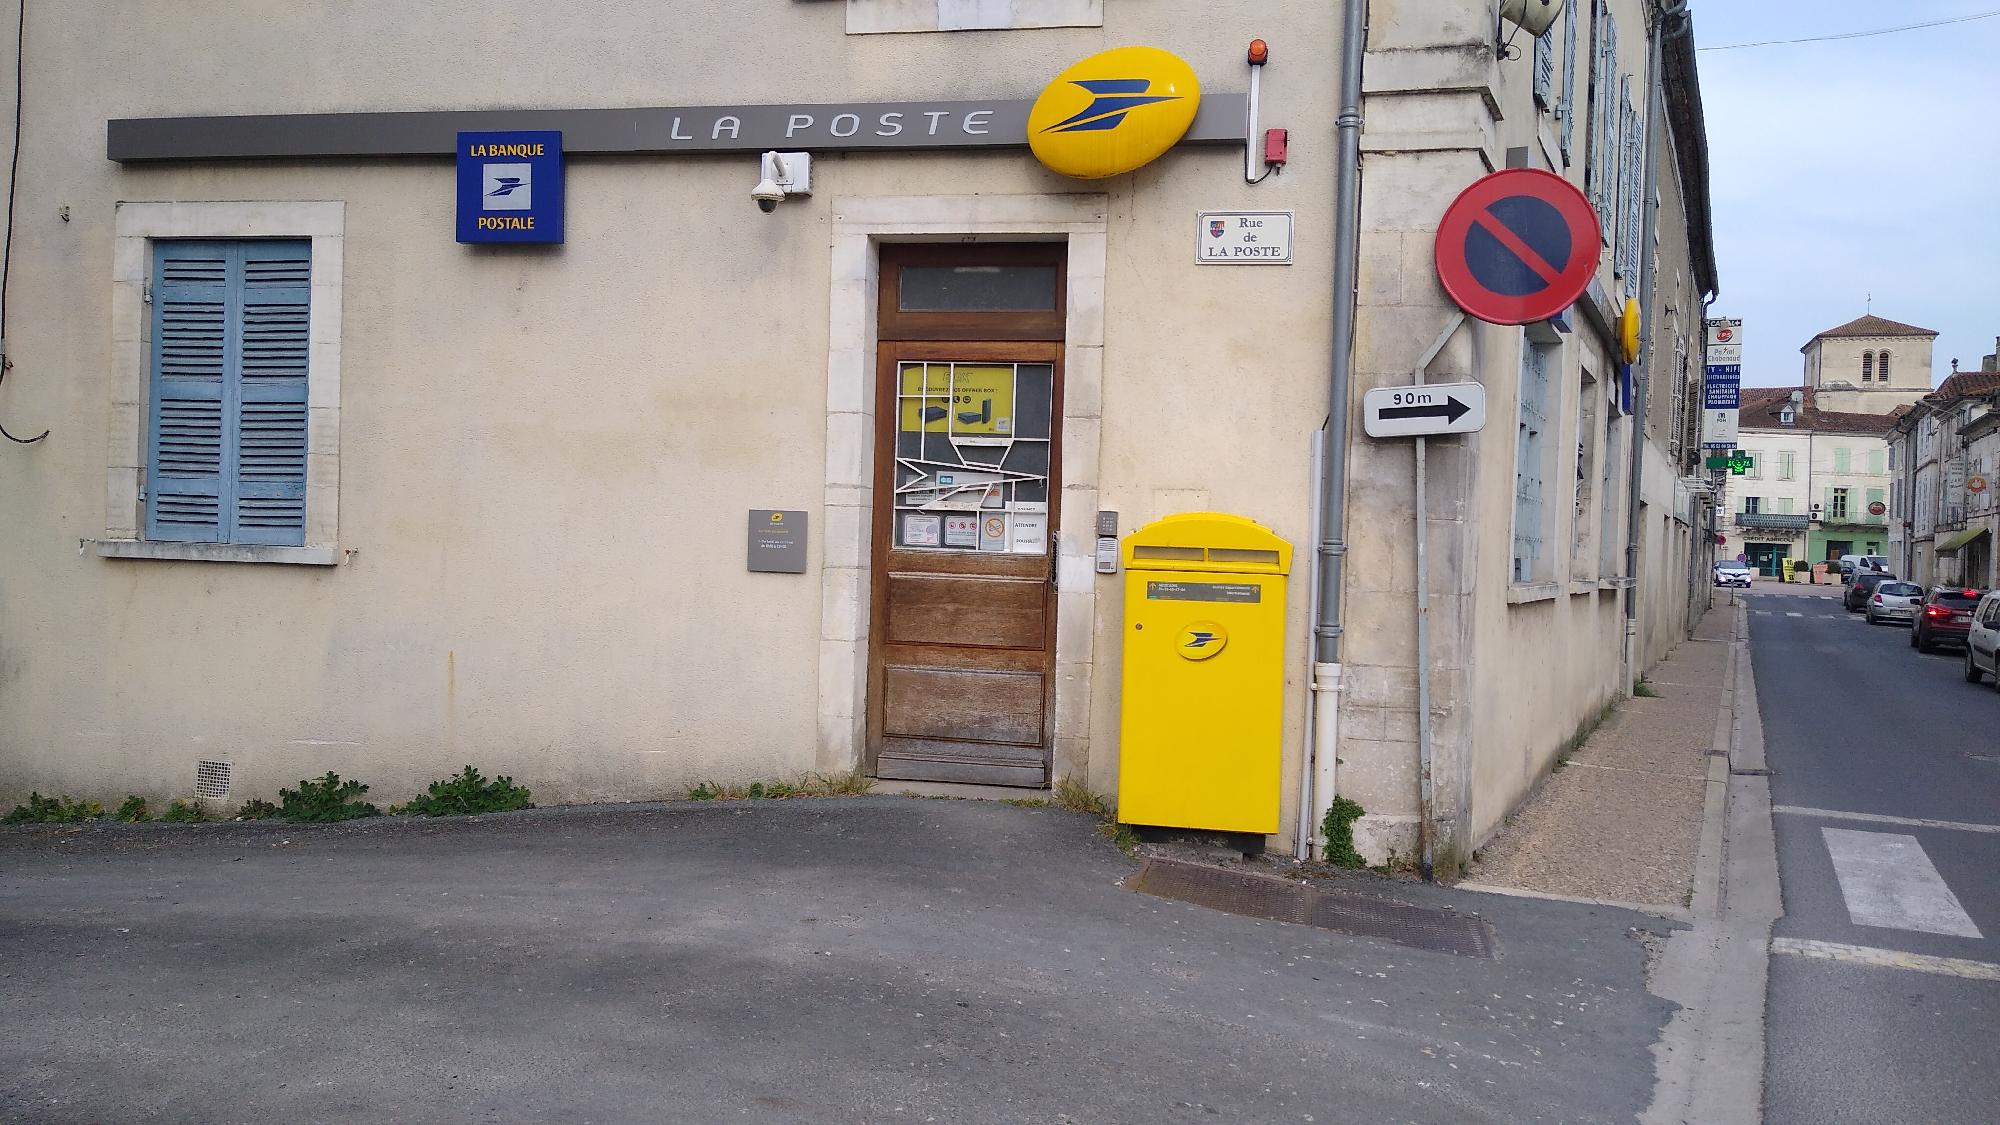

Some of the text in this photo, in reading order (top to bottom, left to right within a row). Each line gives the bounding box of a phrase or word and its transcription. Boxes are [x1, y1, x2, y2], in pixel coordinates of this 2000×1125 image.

[669, 110, 994, 140] LA POSTE
[470, 144, 544, 158] LA BANQUE
[478, 217, 534, 229] POSTALE
[1239, 217, 1263, 228] Rue
[1243, 232, 1257, 242] de
[1208, 246, 1280, 257] LA POSTE
